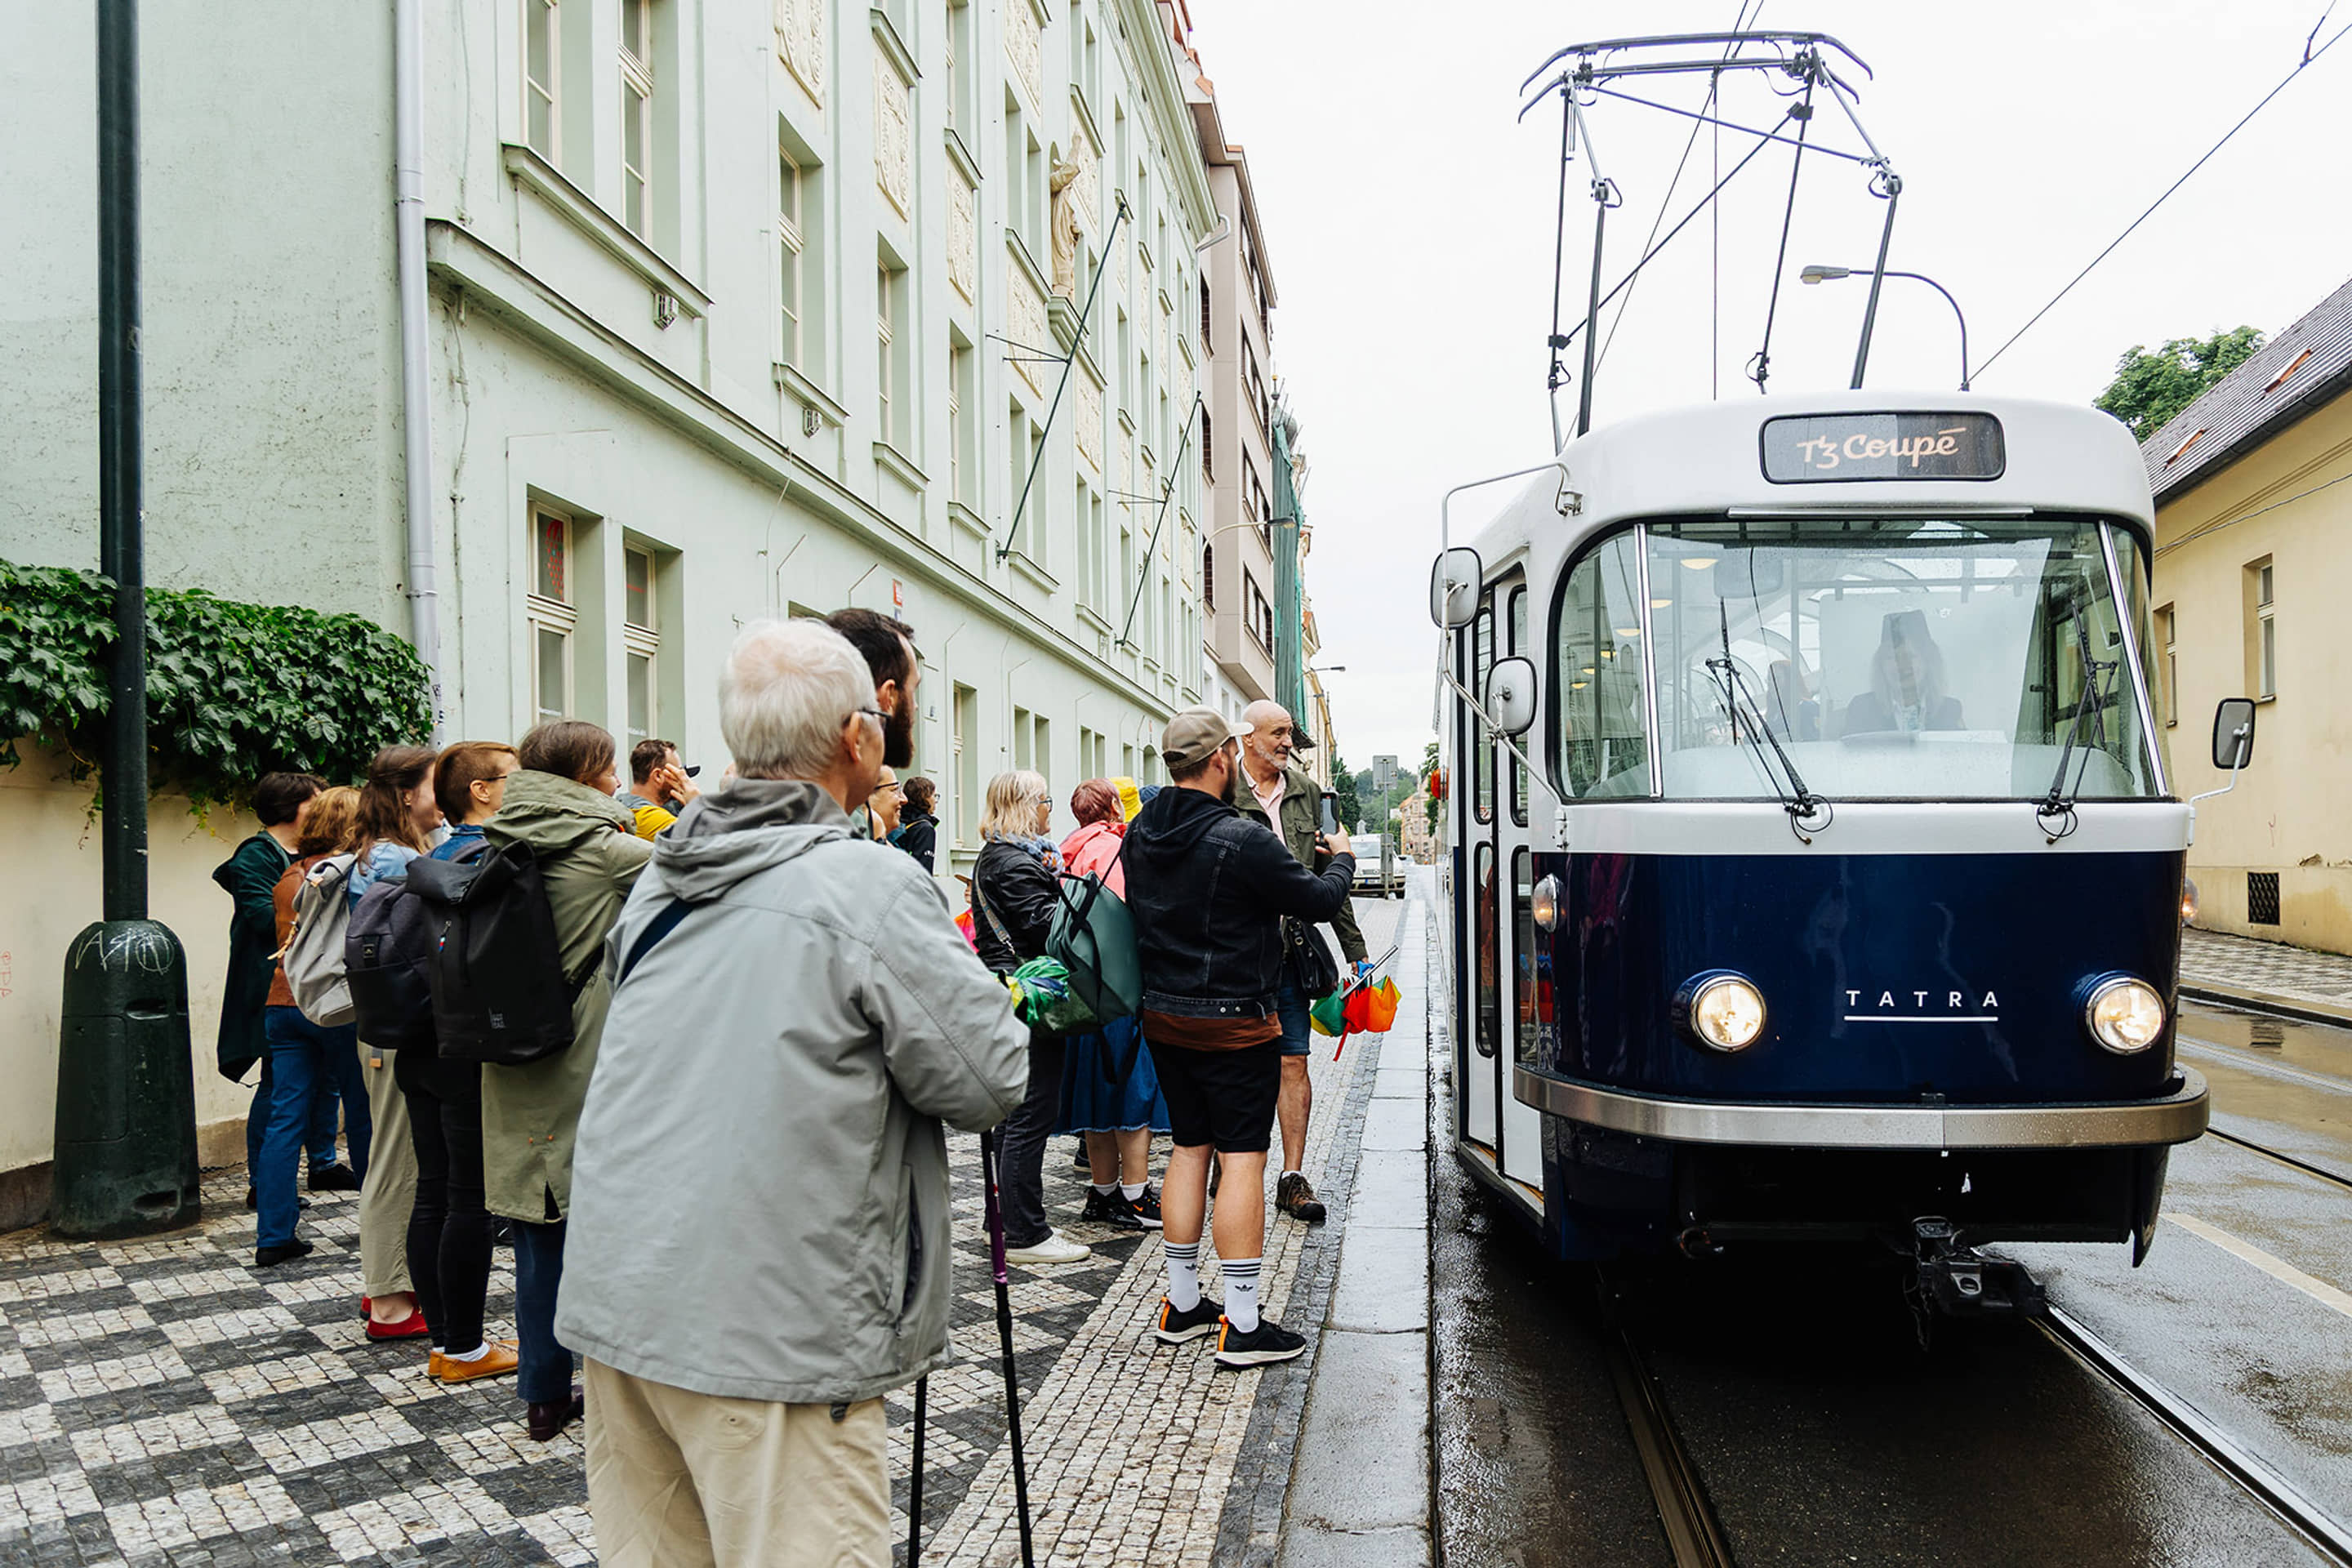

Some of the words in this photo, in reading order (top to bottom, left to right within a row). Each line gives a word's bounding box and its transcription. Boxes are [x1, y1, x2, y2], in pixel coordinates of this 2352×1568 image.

[1797, 434, 1839, 469] T3
[1842, 427, 1967, 467] Coupé
[1846, 990, 1998, 1007] TATRA
